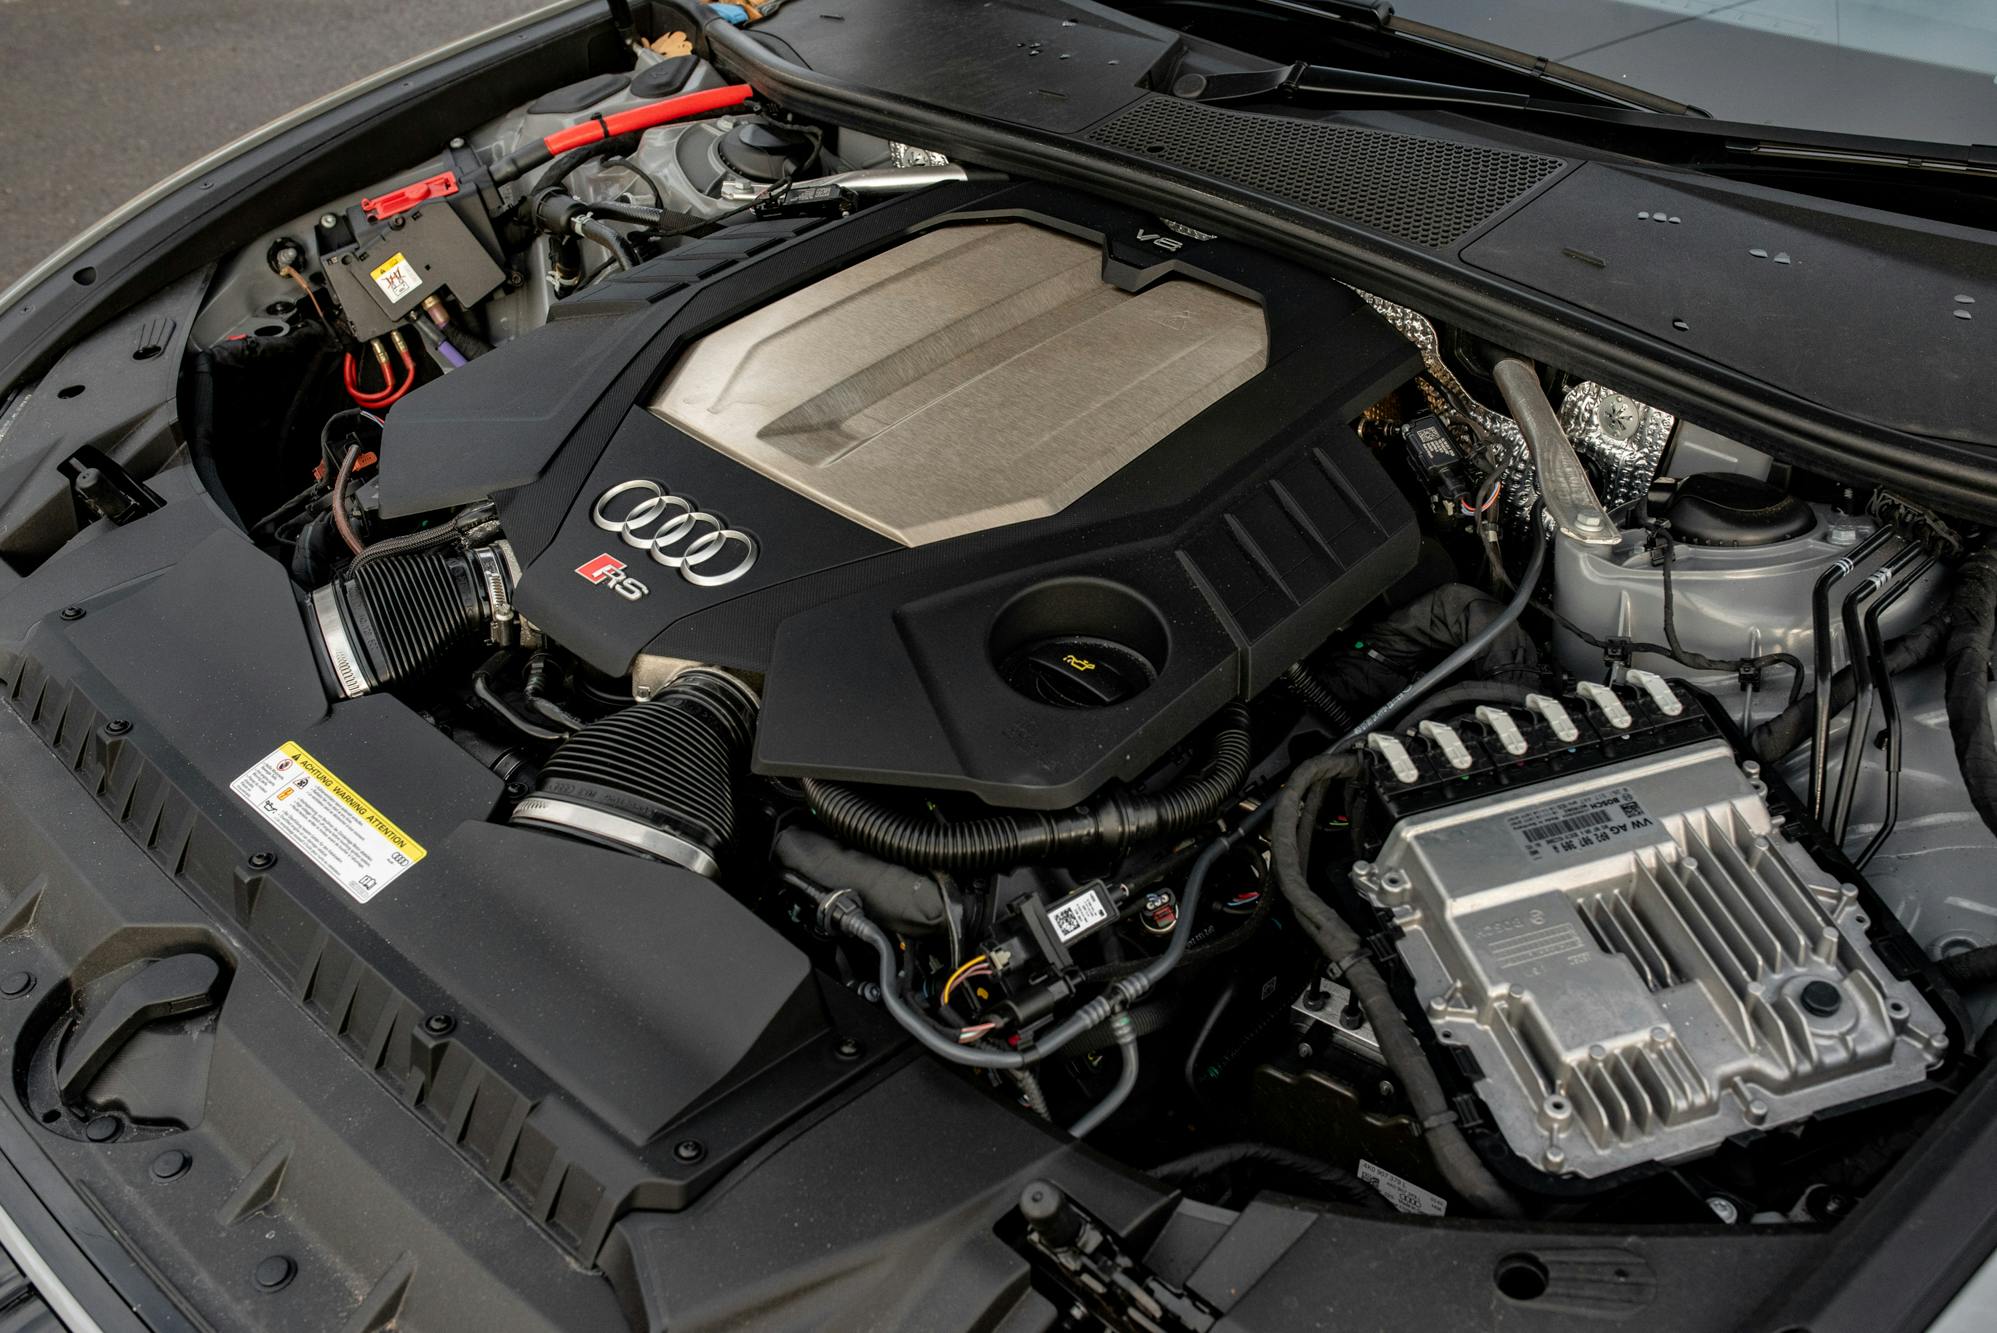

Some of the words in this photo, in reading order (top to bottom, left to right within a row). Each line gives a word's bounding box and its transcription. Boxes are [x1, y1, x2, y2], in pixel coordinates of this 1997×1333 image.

[1136, 228, 1184, 252] V8
[590, 563, 650, 602] RS
[300, 759, 334, 787] ACHTUNG
[332, 785, 367, 815] WARNING
[366, 814, 407, 849] ATTENTION
[1590, 797, 1620, 809] BOSCH
[1609, 823, 1628, 836] AG
[1631, 817, 1654, 830] VW
